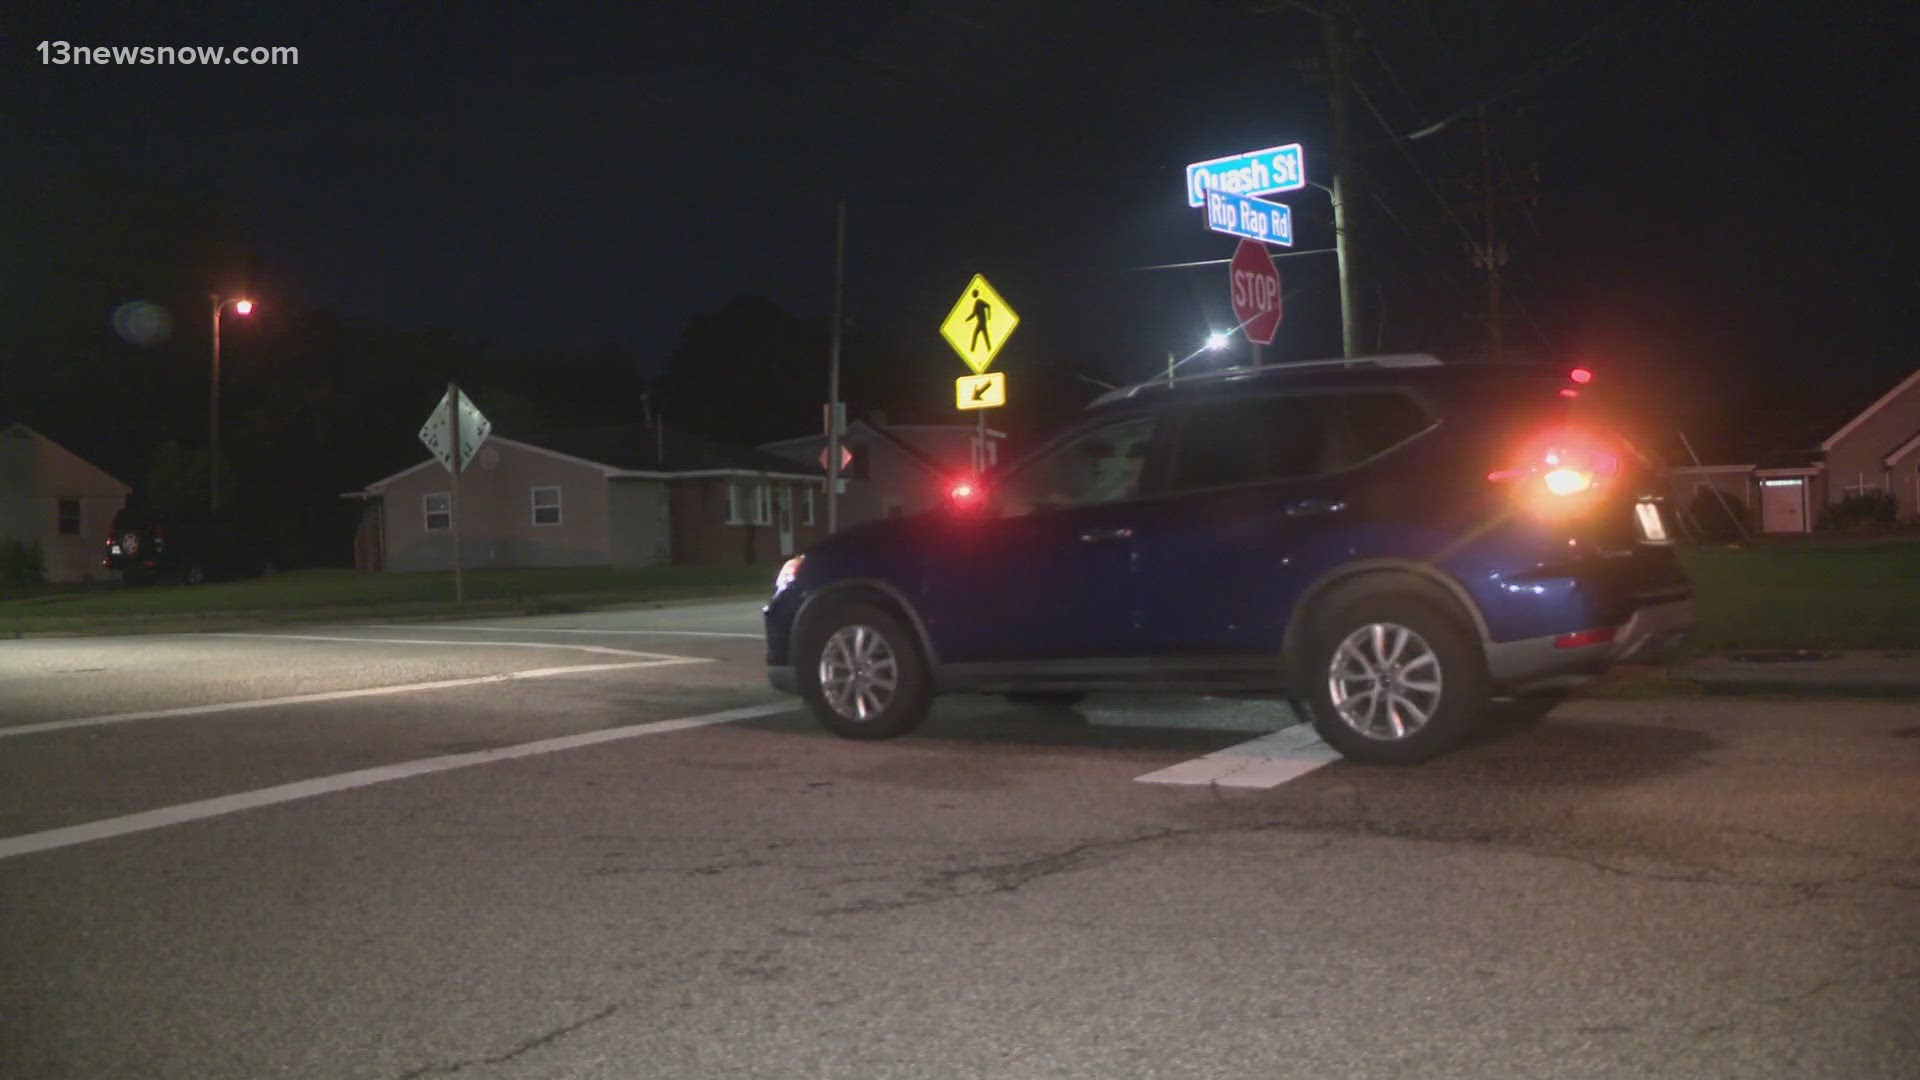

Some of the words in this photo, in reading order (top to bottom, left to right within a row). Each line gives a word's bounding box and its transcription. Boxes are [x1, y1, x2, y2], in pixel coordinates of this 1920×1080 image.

[1194, 158, 1270, 199] Quash
[1272, 153, 1297, 184] St
[1211, 192, 1237, 231] Rip
[1240, 200, 1268, 237] Rap
[1271, 209, 1289, 238] Rd
[1234, 269, 1277, 312] STOP
